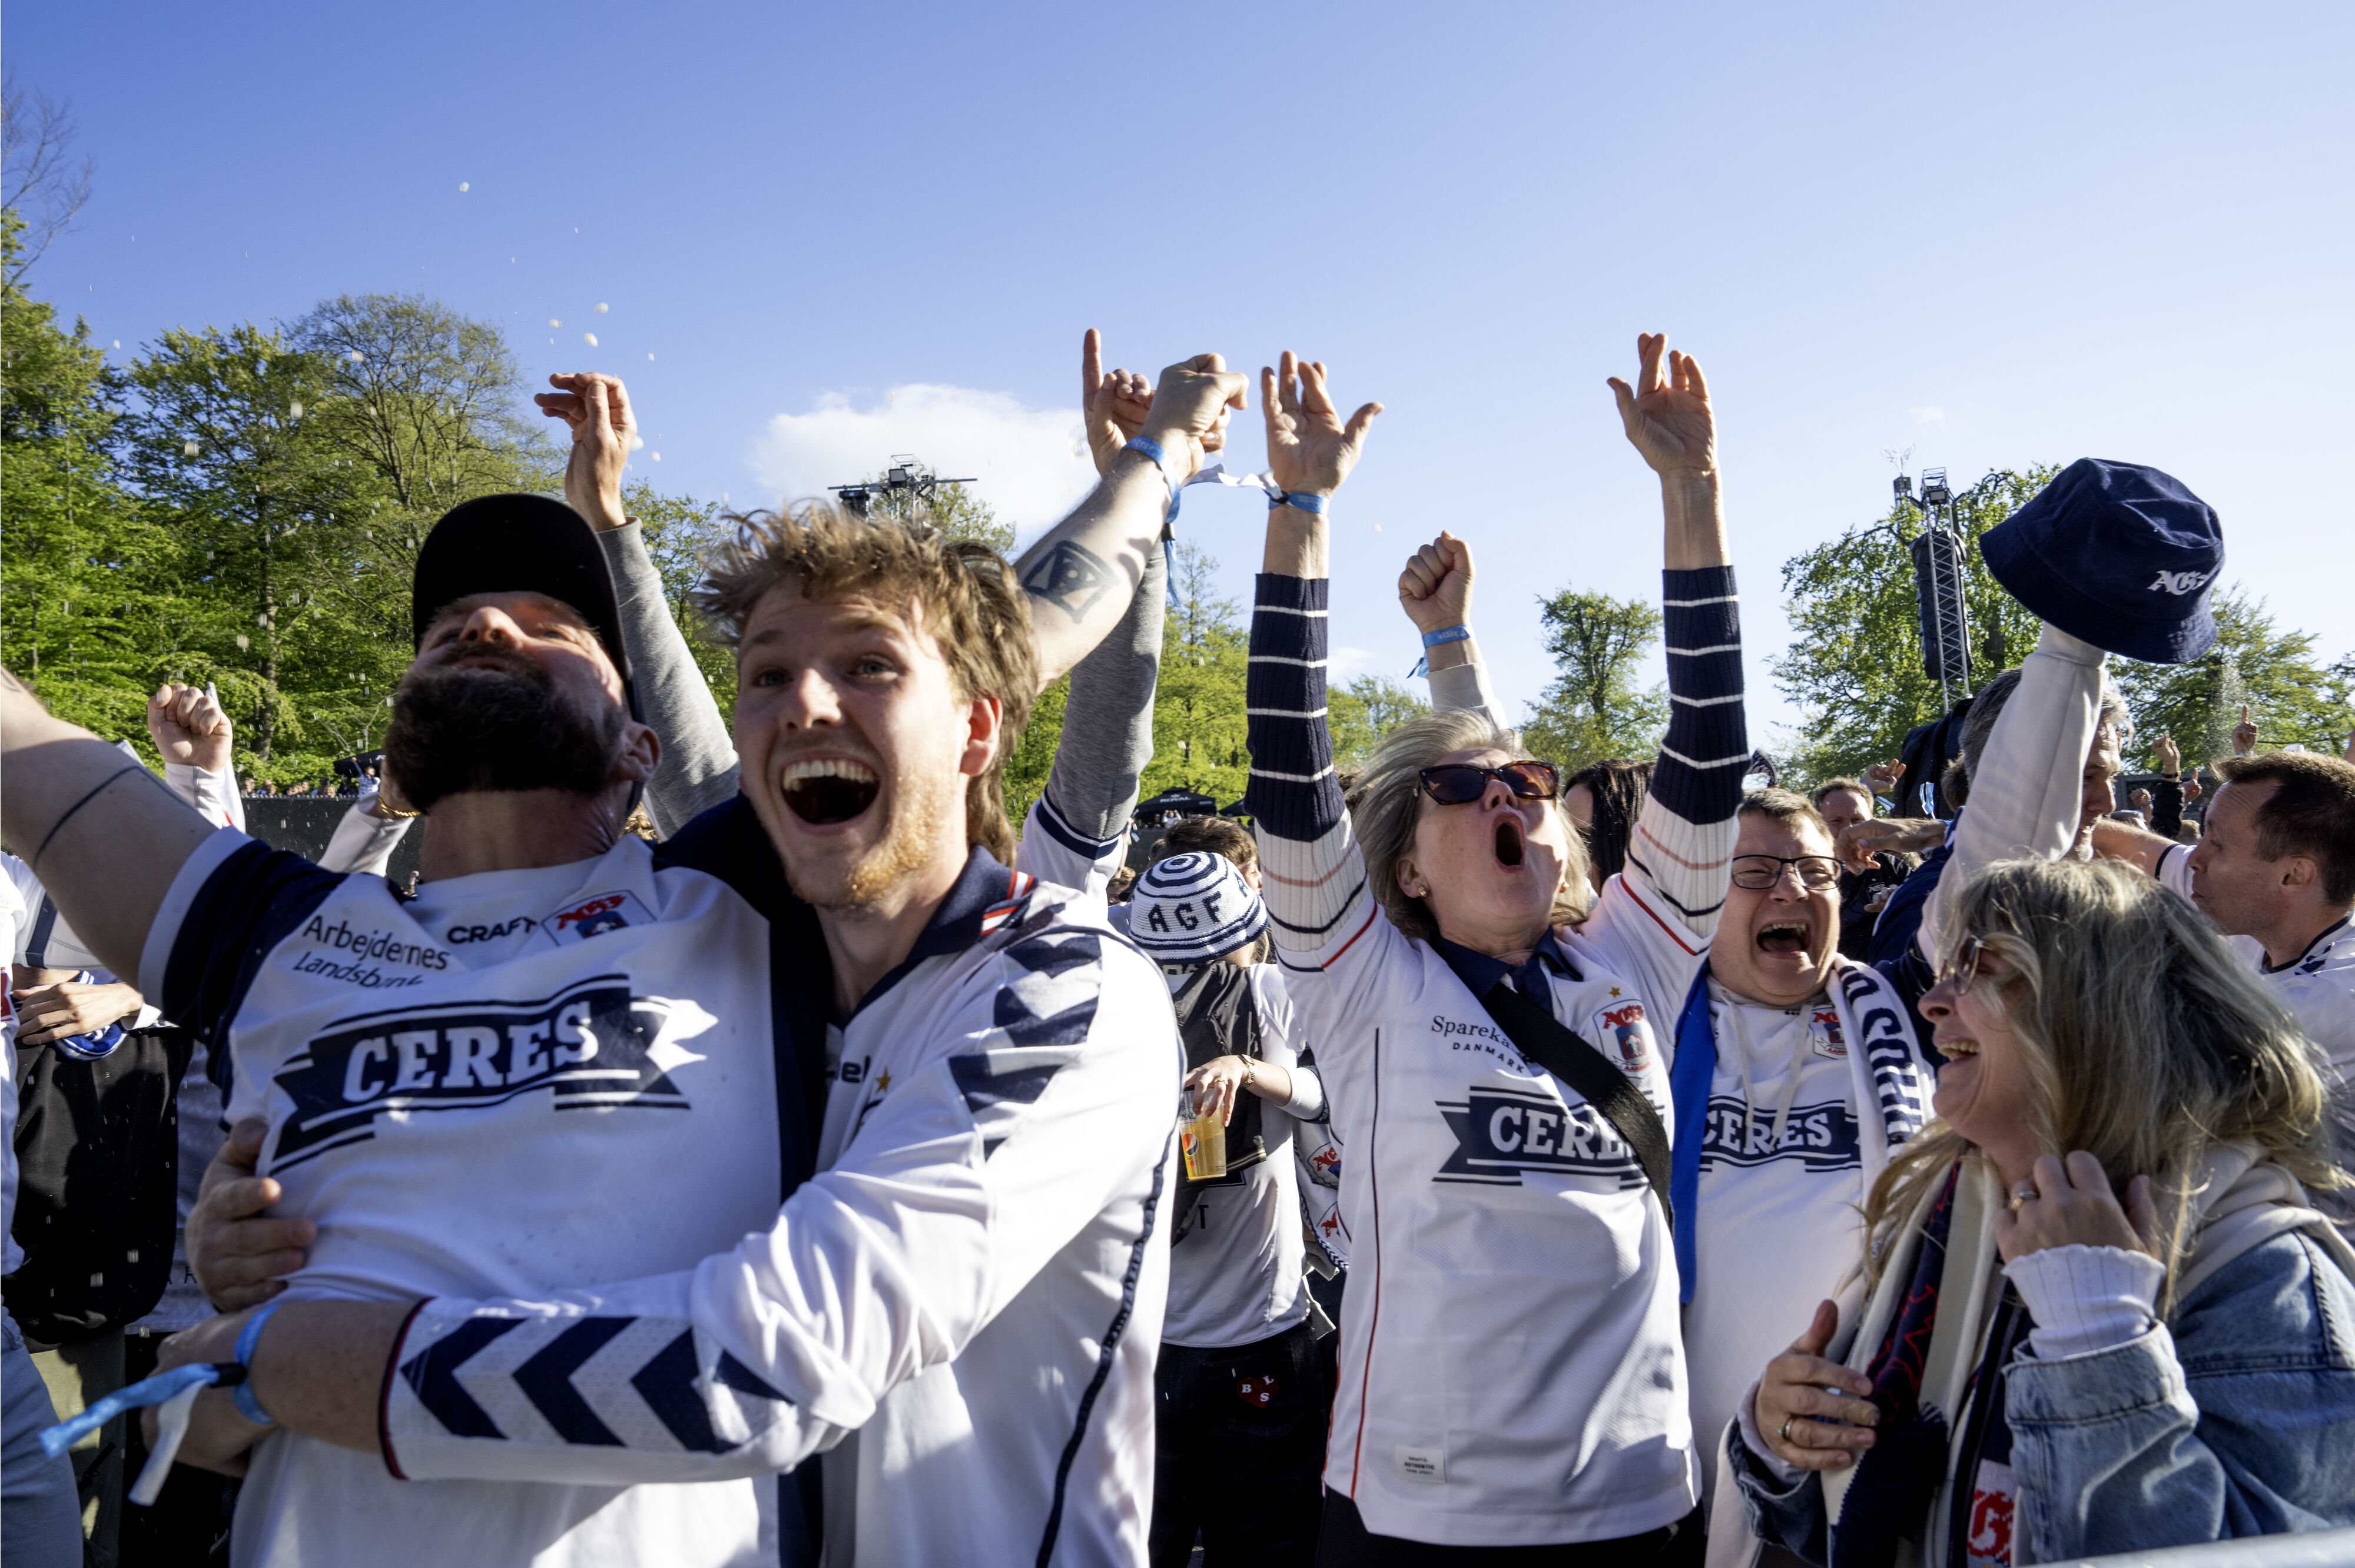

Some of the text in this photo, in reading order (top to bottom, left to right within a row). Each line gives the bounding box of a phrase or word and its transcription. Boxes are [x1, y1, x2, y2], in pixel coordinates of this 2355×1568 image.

[1148, 891, 1222, 932] AGF
[447, 916, 538, 945] CRAFT
[341, 1001, 600, 1102] CERES
[1452, 1042, 1524, 1074] DANMARK
